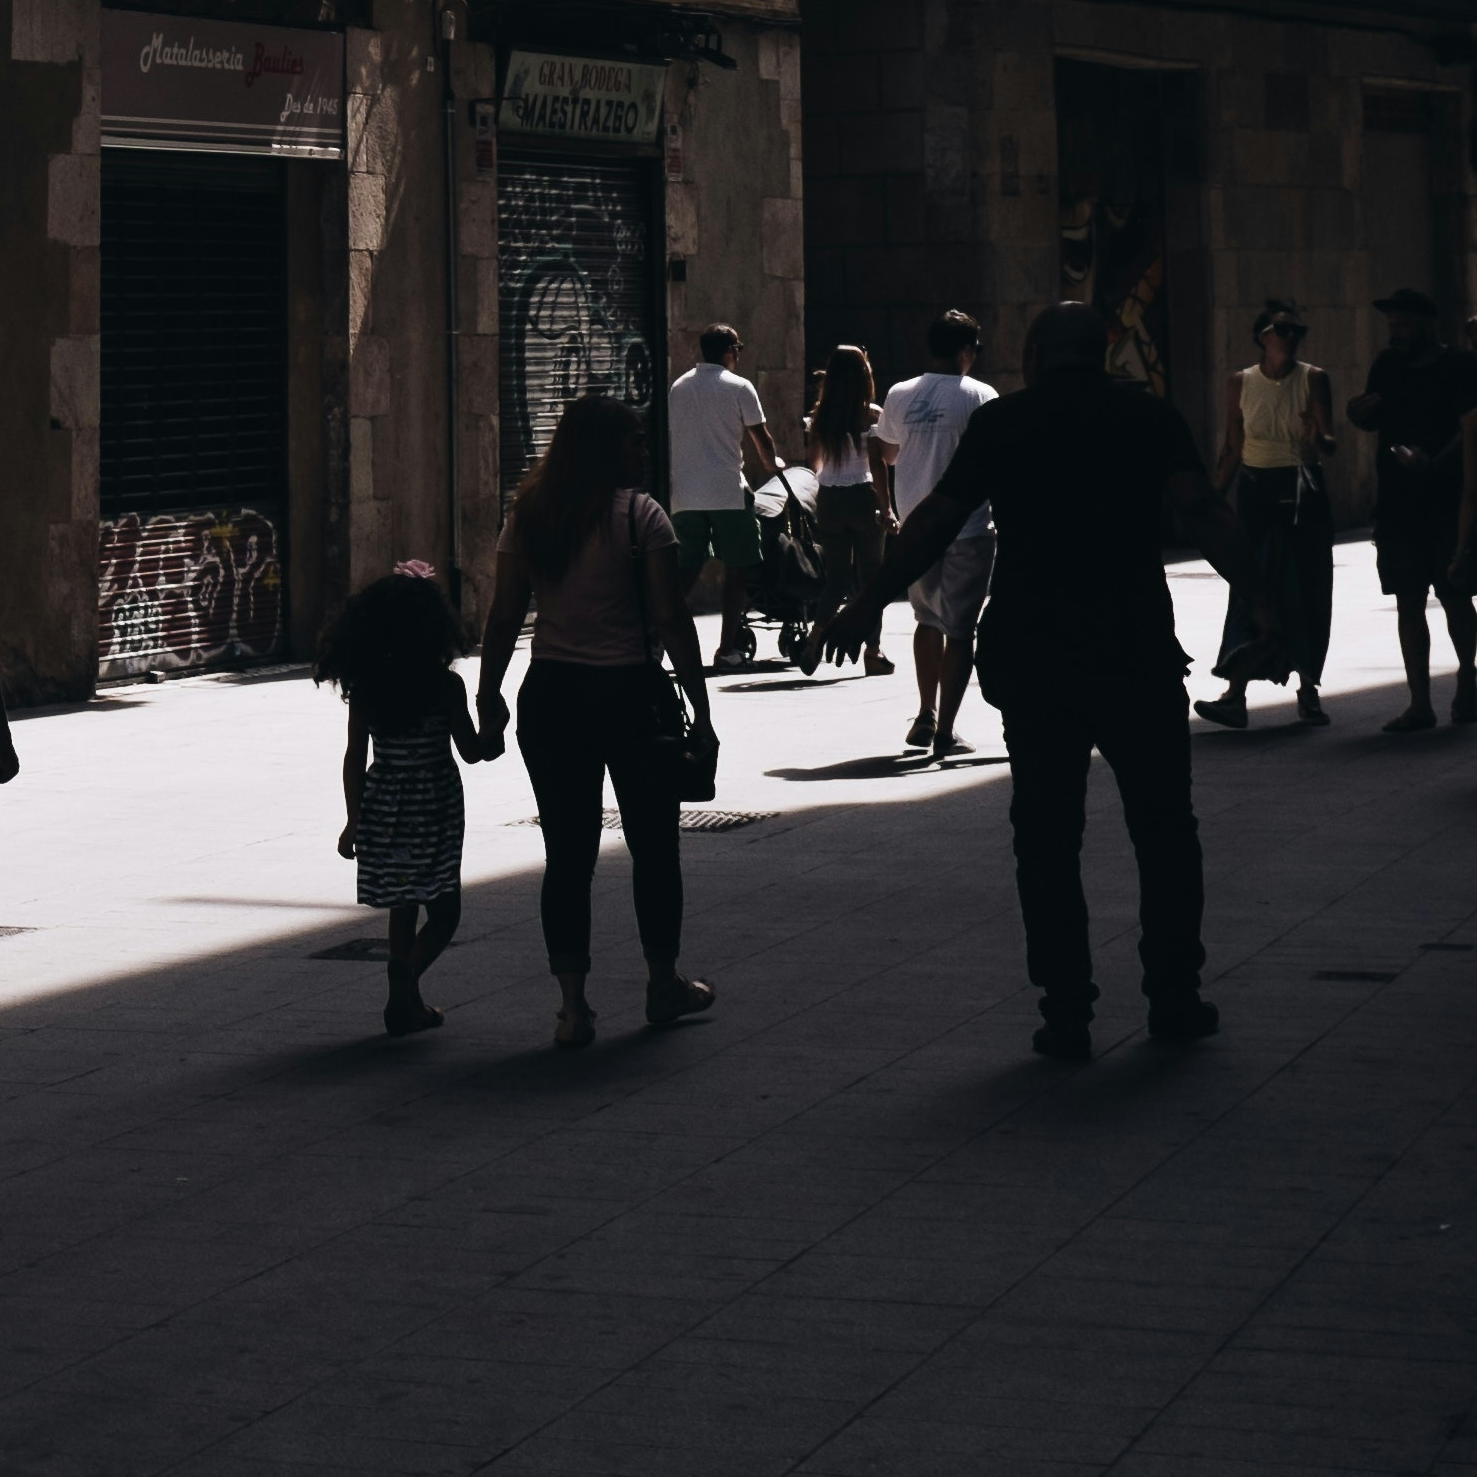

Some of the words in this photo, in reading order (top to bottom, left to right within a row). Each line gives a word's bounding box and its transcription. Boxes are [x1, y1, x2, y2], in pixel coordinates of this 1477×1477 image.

[140, 32, 244, 73] Matalasseria
[538, 60, 575, 87] GRAN
[581, 64, 632, 94] BODEGA
[522, 93, 639, 134] MAESTRAZGO
